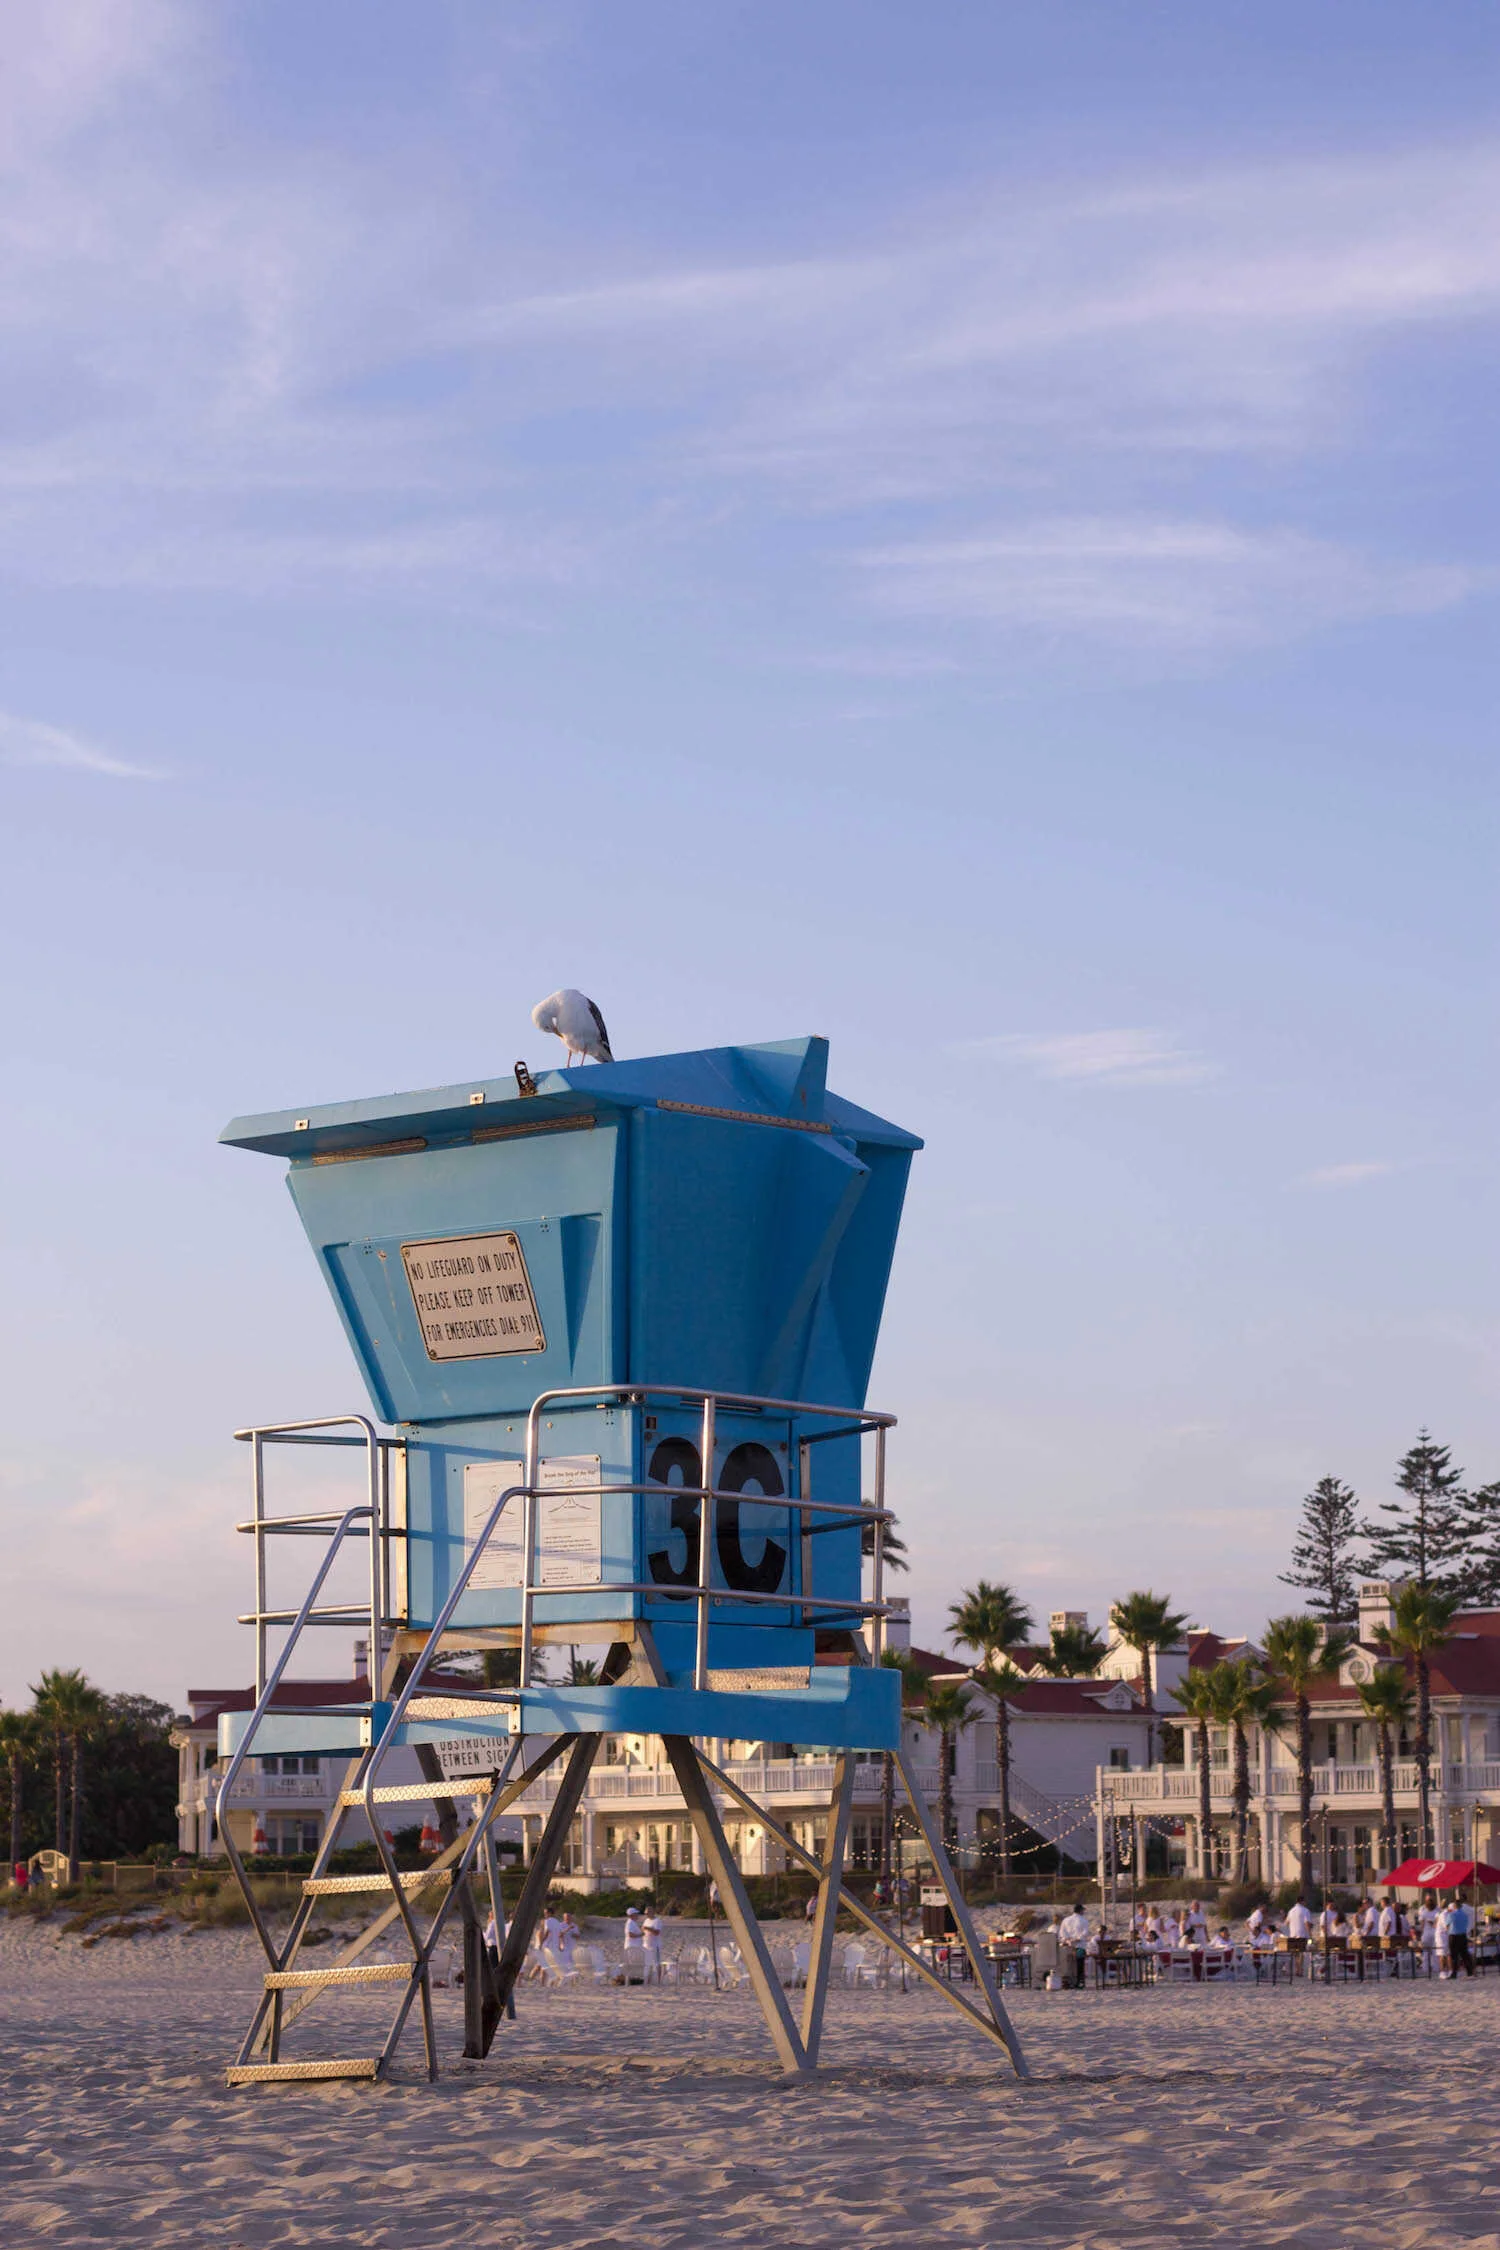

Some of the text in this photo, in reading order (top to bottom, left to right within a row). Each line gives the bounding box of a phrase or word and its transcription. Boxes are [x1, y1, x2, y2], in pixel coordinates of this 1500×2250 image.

[411, 1252, 517, 1281] NO LIFEGUARD ON DUTY
[418, 1283, 527, 1311] PLEASE KEEP OFF TOWER
[426, 1314, 535, 1342] FOR EMERGENCIES DIAL 911
[648, 1437, 786, 1604] 3C
[437, 1750, 480, 1767] ETWEEN
